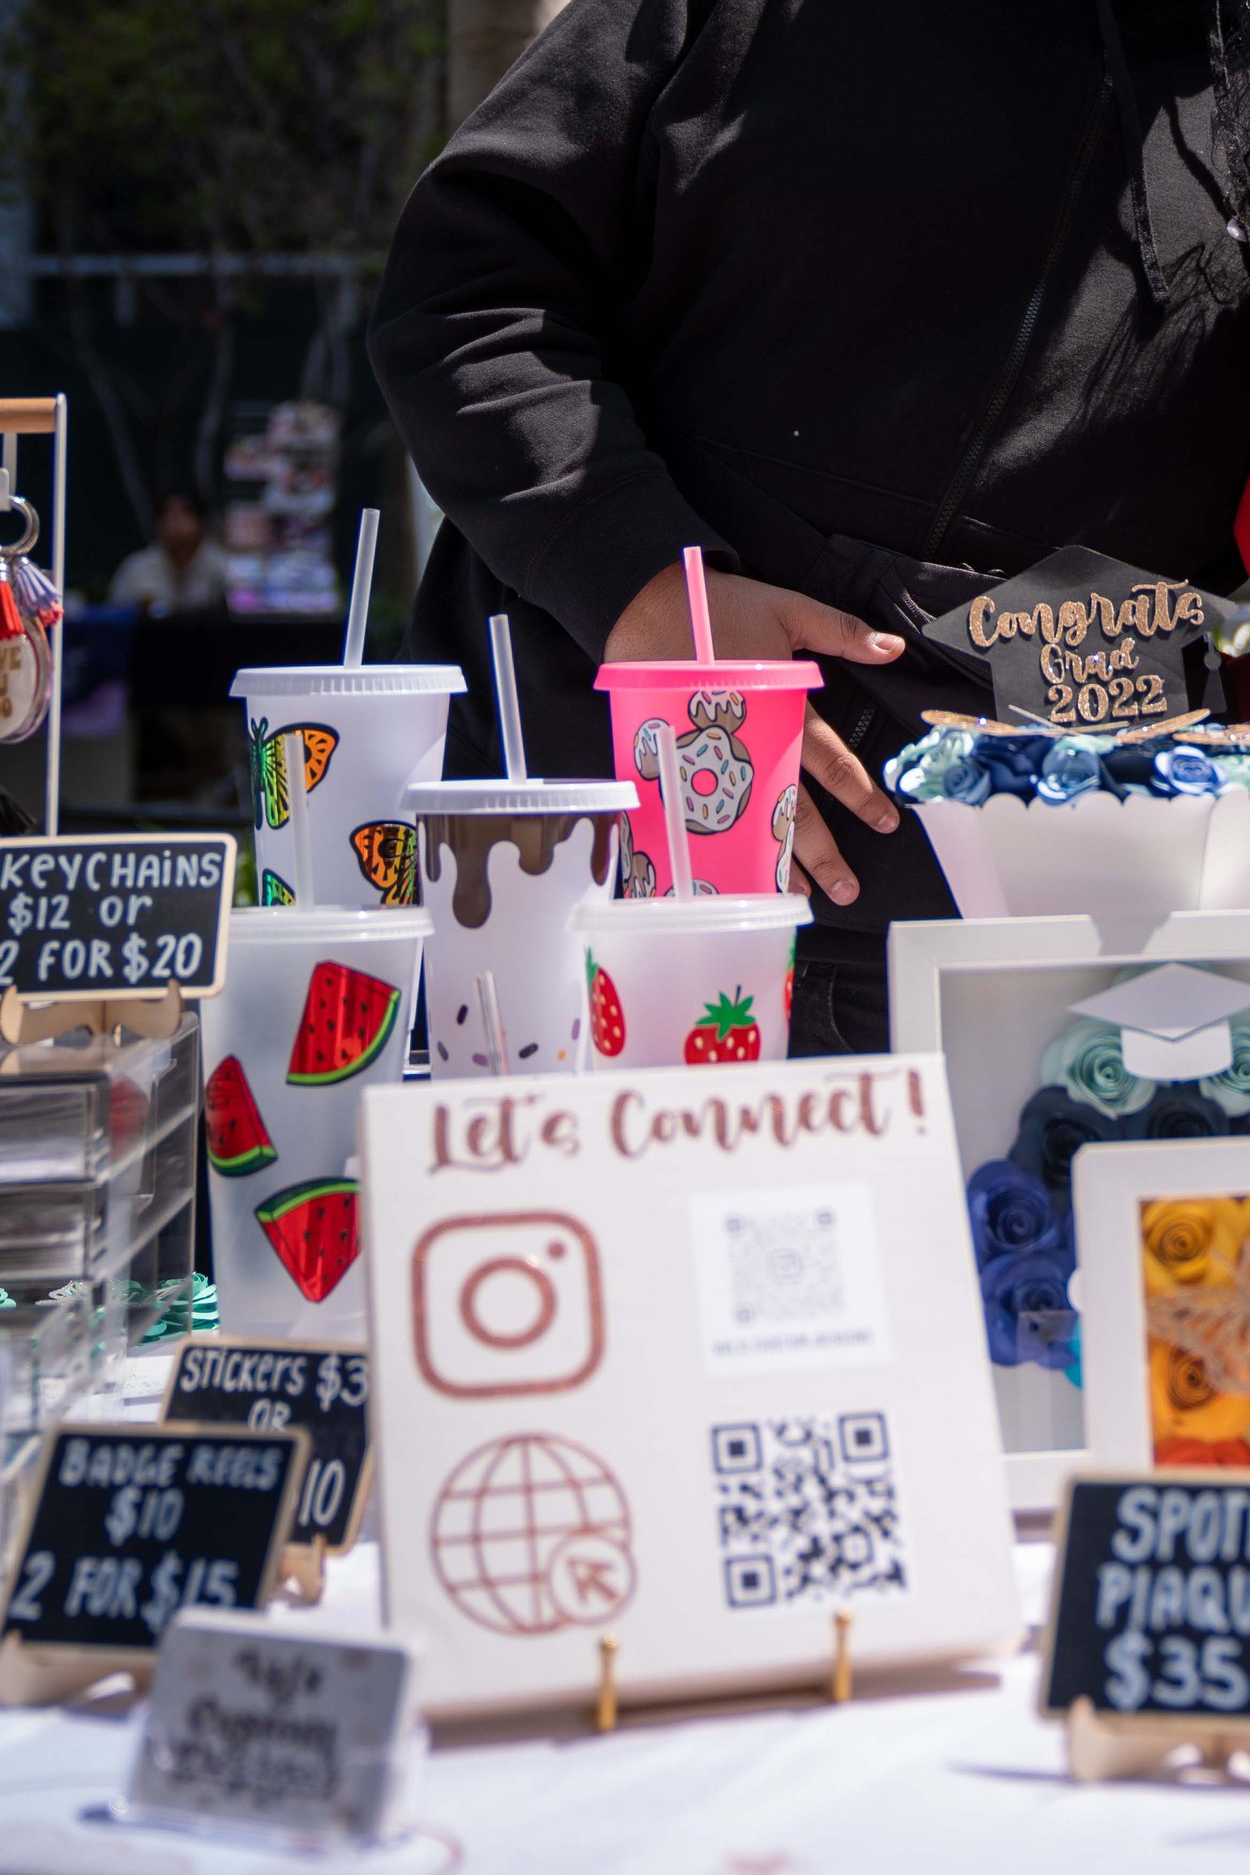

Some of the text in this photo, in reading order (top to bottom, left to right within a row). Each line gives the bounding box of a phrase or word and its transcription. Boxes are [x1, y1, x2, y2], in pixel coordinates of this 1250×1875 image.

[969, 578, 1205, 647] Congrats
[1040, 637, 1140, 685] Grad
[1048, 674, 1168, 723] 2022
[8, 892, 71, 936] $12
[0, 932, 203, 985] 2 FOR $20
[428, 1091, 580, 1175] Let's
[315, 1351, 369, 1412] $3
[248, 1398, 291, 1432] OR
[59, 1437, 184, 1488] BADGE
[105, 1486, 185, 1547] $10
[9, 1549, 240, 1635] 2 FOR $15
